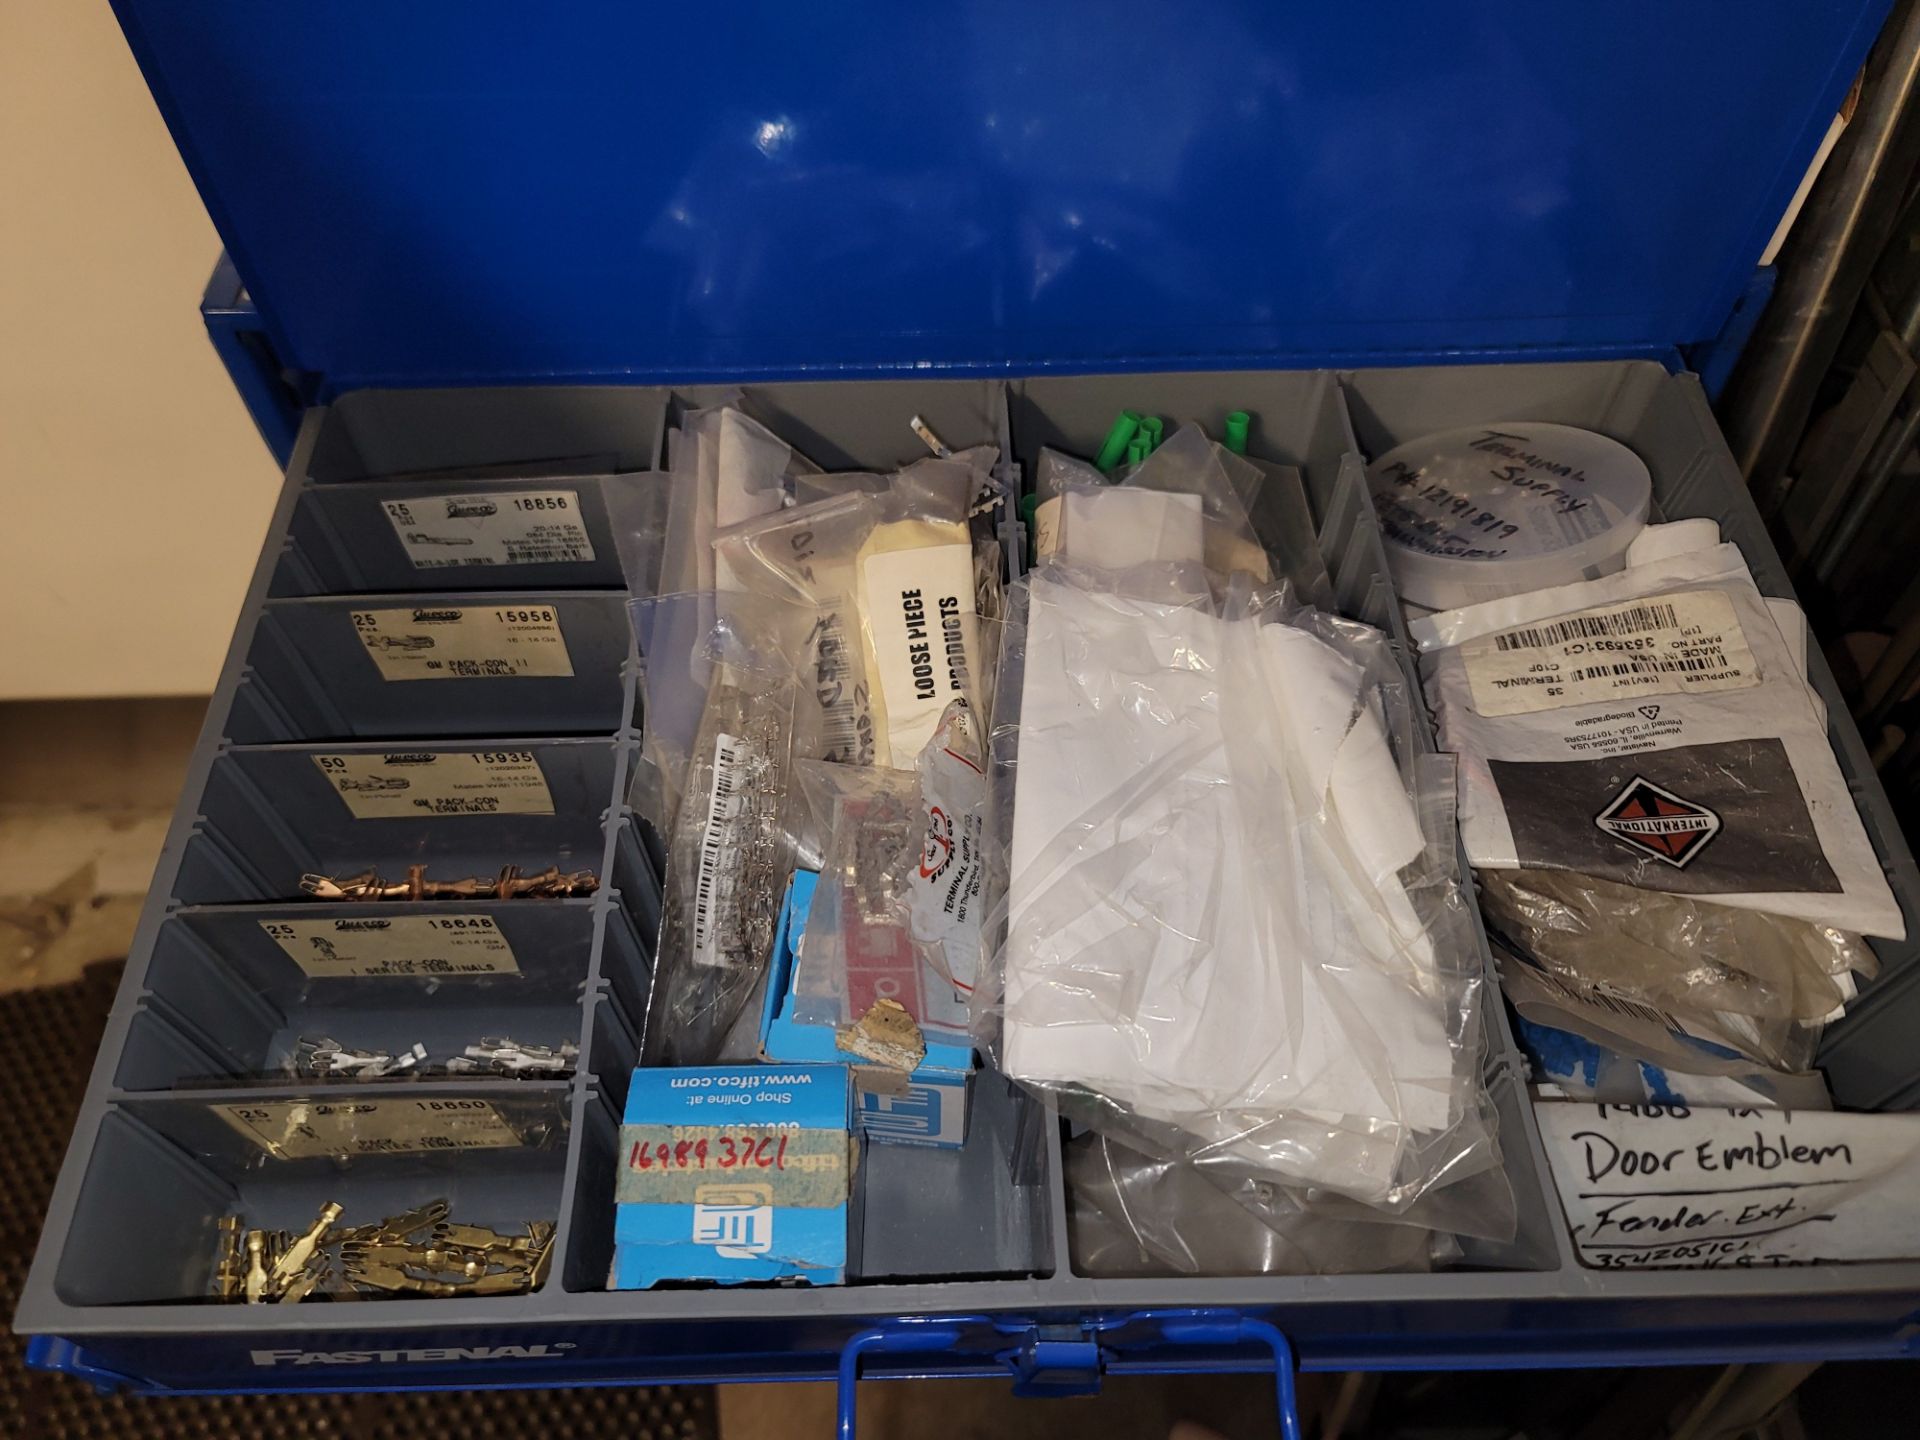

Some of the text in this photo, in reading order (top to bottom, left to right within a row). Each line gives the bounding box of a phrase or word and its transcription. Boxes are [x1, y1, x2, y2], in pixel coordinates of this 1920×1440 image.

[387, 503, 410, 517] 25
[513, 497, 568, 511] 18856
[353, 613, 377, 626] 25
[495, 610, 553, 623] 15958
[902, 587, 937, 701] LOOSE PIECE
[938, 595, 972, 692] PRODUCTS
[1691, 635, 1723, 650] PART
[1681, 644, 1722, 658] MADE
[448, 658, 509, 669] PACK-CON
[449, 666, 517, 676] TERMINALS
[1684, 668, 1741, 683] SUPPLIER
[1490, 673, 1564, 689] TERMINAL
[1546, 686, 1565, 697] 35
[1574, 710, 1637, 728] Biodegradable
[1650, 718, 1684, 730] Printed
[1618, 724, 1641, 735] USA
[320, 756, 345, 768] 50
[471, 752, 533, 765] 15935
[429, 803, 497, 813] TERMINALS
[1607, 817, 1709, 834] INTERNATIONAL
[944, 864, 969, 914] TERMINAL
[266, 924, 294, 935] 25
[428, 918, 493, 929] 18648
[421, 963, 495, 973] TERMINALS
[670, 1074, 812, 1089] www.tifco.com
[685, 1092, 792, 1107] Shop Online at:
[239, 1109, 270, 1119] 25
[1571, 1131, 1852, 1184] Door Emblem
[250, 1345, 566, 1367] FASTENAL
